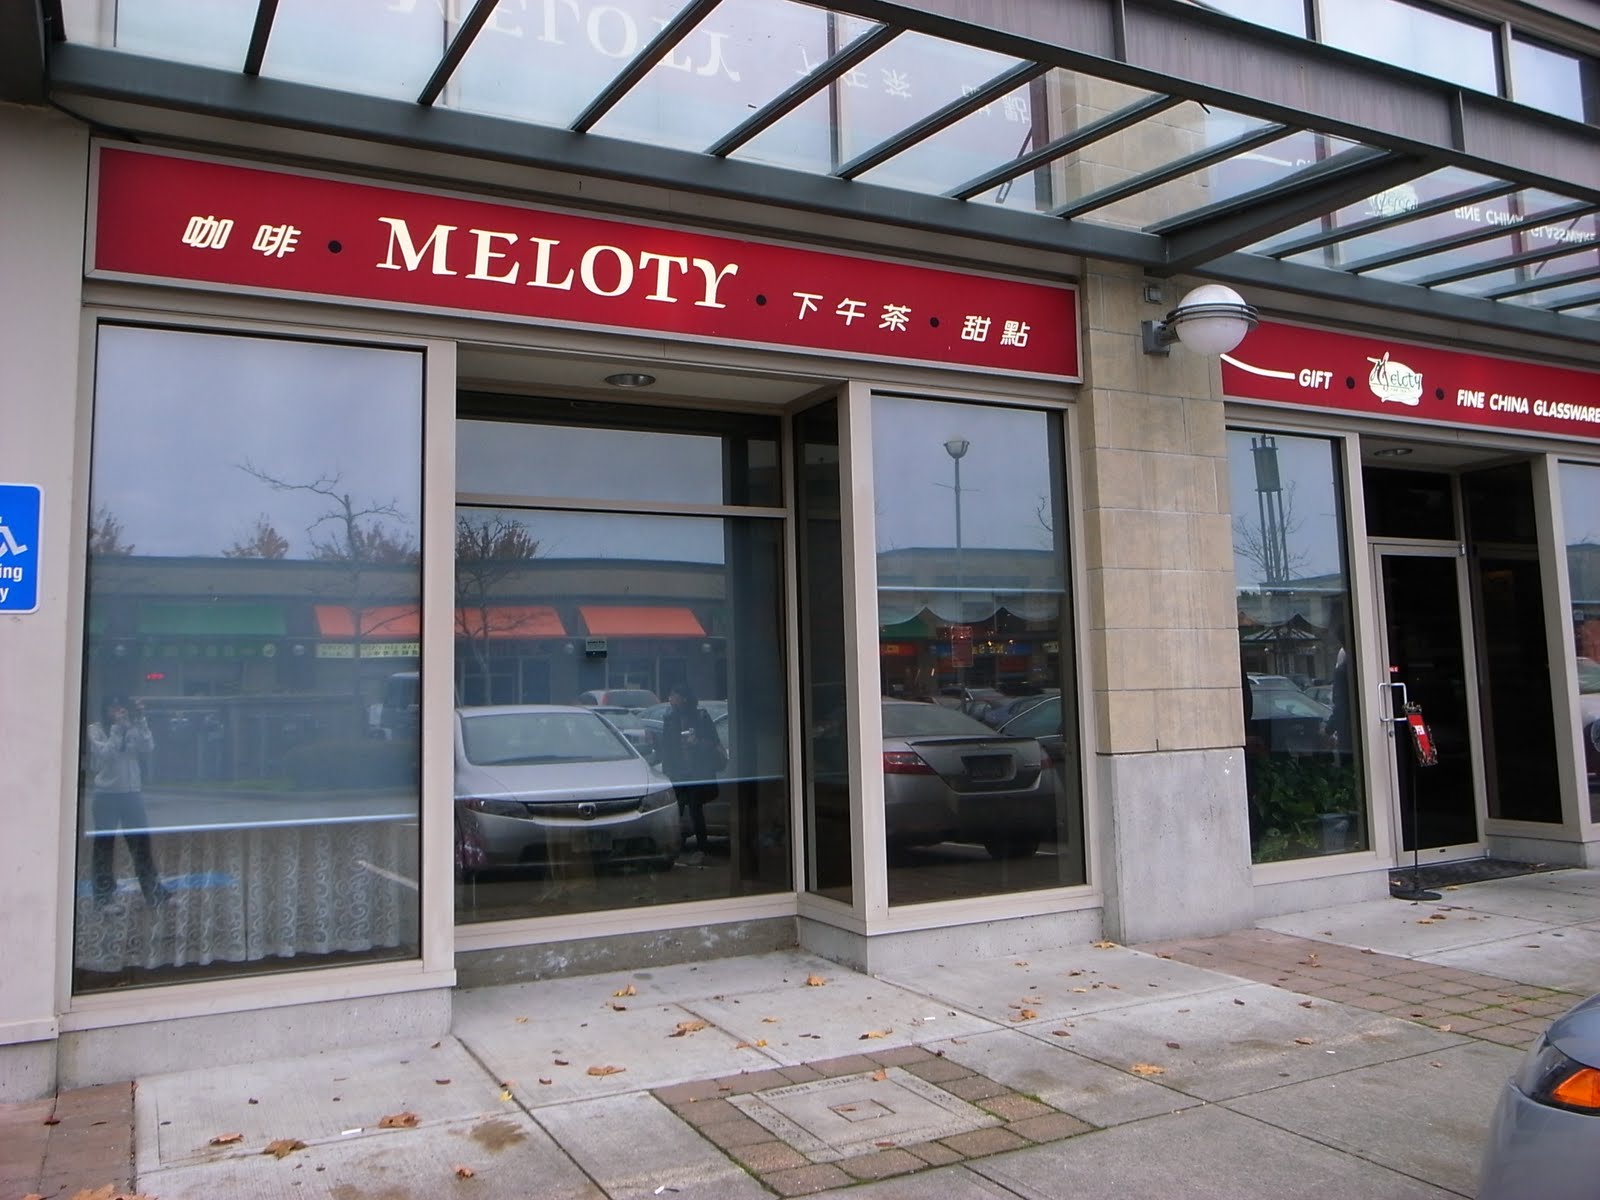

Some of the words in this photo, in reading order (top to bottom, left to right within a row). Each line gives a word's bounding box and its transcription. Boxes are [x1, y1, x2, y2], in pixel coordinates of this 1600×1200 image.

[182, 215, 301, 258] 咖啡
[376, 216, 739, 310] MELOTY
[792, 291, 912, 332] 下午茶
[960, 315, 1031, 347] 甜點
[1298, 368, 1333, 390] GIFT
[1456, 389, 1486, 409] FINE
[1489, 393, 1530, 415] CHINA
[1533, 399, 1600, 424] GLASSWARE
